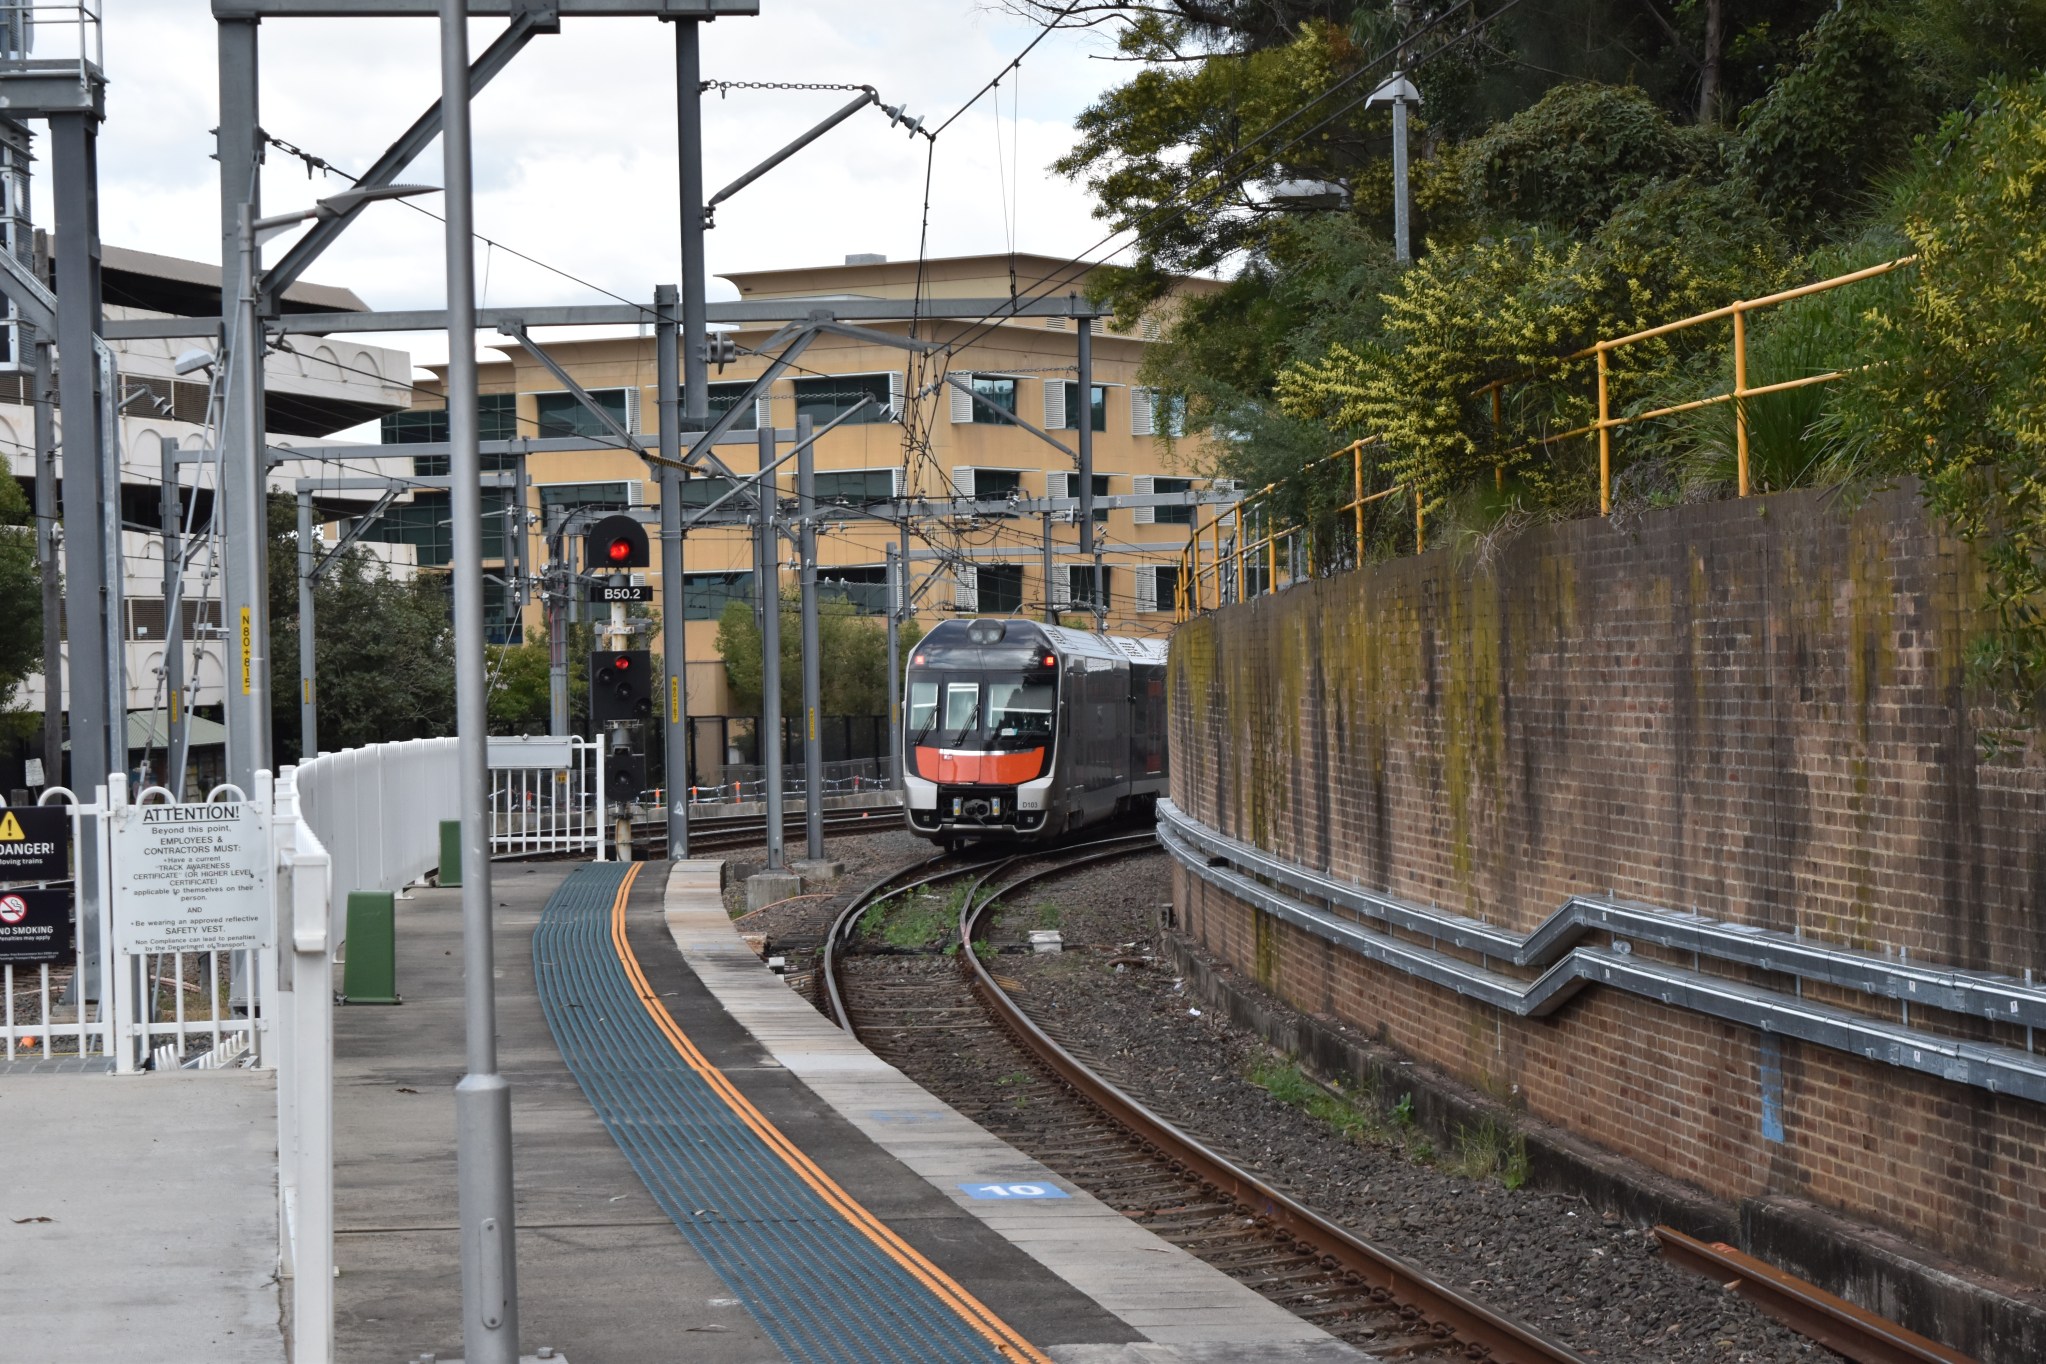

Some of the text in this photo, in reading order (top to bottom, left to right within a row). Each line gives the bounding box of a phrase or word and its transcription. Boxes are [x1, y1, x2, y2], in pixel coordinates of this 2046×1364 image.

[604, 588, 641, 600] B50.2
[143, 805, 240, 822] ATTENTION!
[152, 827, 184, 836] Beyond
[208, 825, 232, 834] point,
[160, 836, 213, 845] EMPLOYEES
[144, 844, 241, 856] CONTRACTORS MUST:
[190, 917, 223, 925] approved
[12, 925, 54, 935] SMOKING
[979, 1184, 1046, 1196] 10
